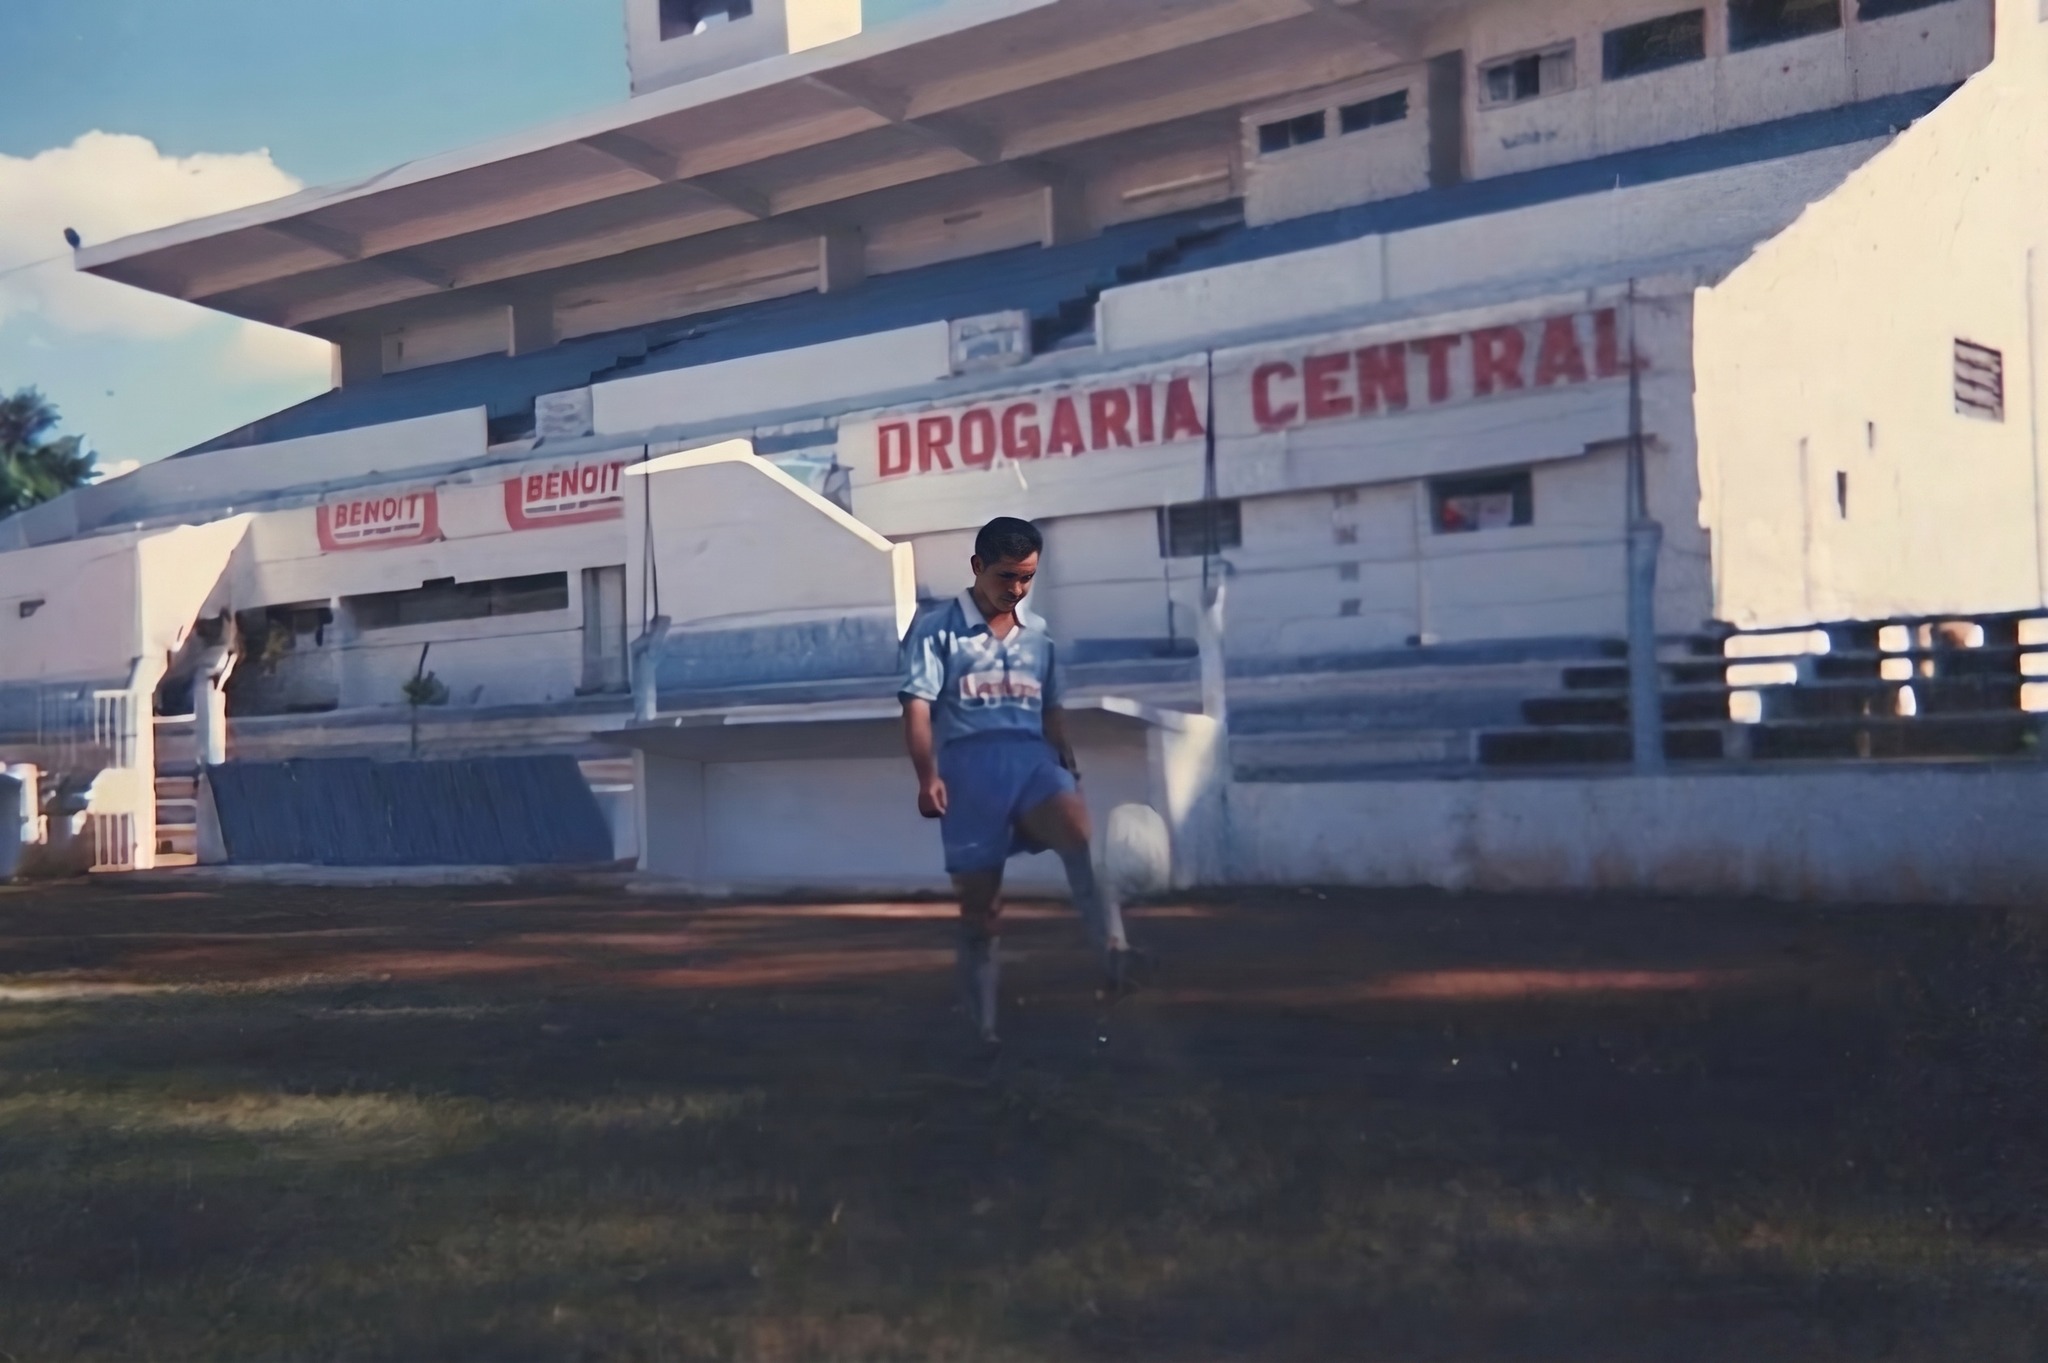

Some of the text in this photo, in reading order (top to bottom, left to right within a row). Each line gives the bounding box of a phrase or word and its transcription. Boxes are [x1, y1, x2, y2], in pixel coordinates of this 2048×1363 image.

[878, 309, 1650, 477] DROGARIA CENTRAL
[526, 461, 625, 502] BENOIT
[334, 494, 420, 529] BENOIT
